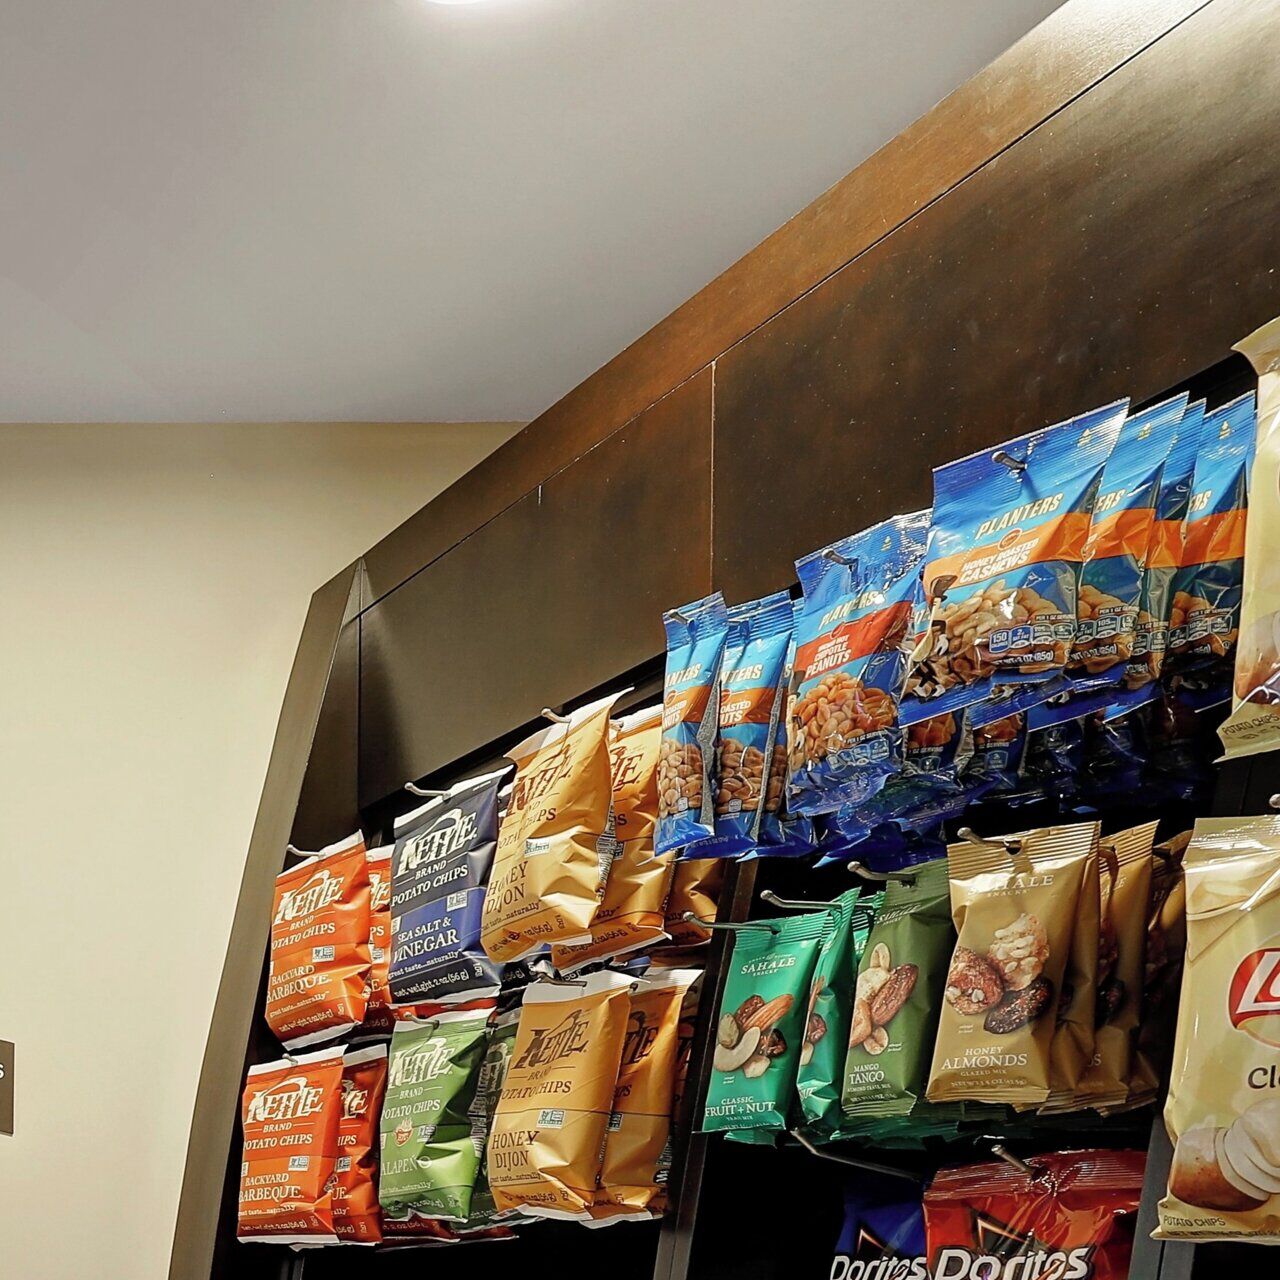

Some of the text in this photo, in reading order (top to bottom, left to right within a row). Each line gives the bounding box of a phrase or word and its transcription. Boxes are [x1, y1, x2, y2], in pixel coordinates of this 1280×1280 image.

[975, 493, 1064, 541] PLANTERS
[962, 538, 1040, 573] HONEY ROASTED
[959, 551, 1030, 584] CASHEWS
[991, 632, 1008, 643] 150
[806, 649, 852, 679] PEANUTS
[1223, 718, 1254, 737] POTATO
[394, 808, 478, 879] KETTLE
[415, 860, 447, 881] BRAND
[392, 864, 469, 907] POTATO CHIPS
[987, 888, 1029, 898] SNACKS
[272, 869, 345, 927] KETTLE
[289, 915, 315, 931] BRAND
[302, 922, 336, 941] CHIPS
[398, 921, 442, 945] SEA SALT
[393, 928, 461, 964] VINEGAR
[271, 964, 315, 986] BACKYARD
[740, 957, 797, 975] SAHALE
[752, 968, 779, 977] SNACKS
[511, 1009, 590, 1070] KETTLE
[965, 1046, 1005, 1056] HONEY
[389, 1038, 456, 1089] KETTLE
[853, 1063, 880, 1073] MANGO
[941, 1053, 1029, 1071] ALMONDS
[848, 1070, 886, 1085] TANGO
[960, 1070, 992, 1078] GLAZED
[244, 1076, 324, 1125] KETTLE
[399, 1086, 424, 1100] BRAND
[721, 1096, 755, 1106] CLASSIC
[412, 1099, 441, 1115] CHIPS
[705, 1101, 776, 1118] FRUIT NUT
[262, 1122, 293, 1134] BRAND
[279, 1133, 313, 1147] CHIPS
[492, 1130, 540, 1150] HONEY
[495, 1151, 529, 1172] DIJON
[245, 1173, 290, 1187] BACKYARD
[239, 1185, 304, 1203] BARBEQUE
[1163, 1215, 1226, 1227] POTATO CHIPS
